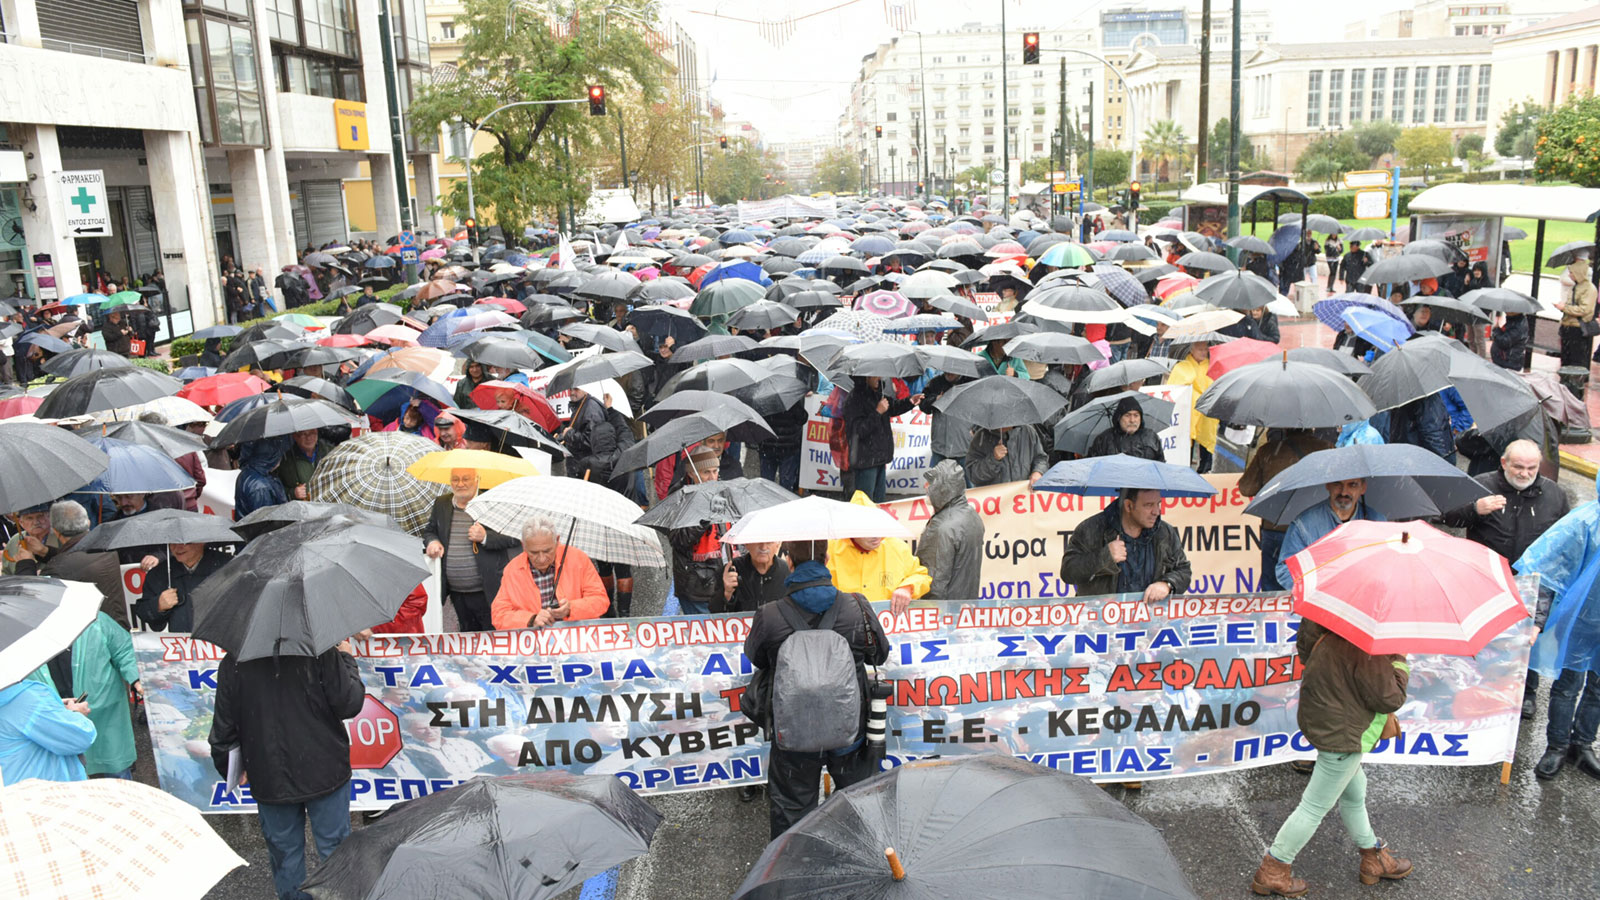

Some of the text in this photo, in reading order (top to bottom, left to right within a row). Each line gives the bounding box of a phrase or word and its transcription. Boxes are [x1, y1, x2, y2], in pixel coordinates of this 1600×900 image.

[61, 174, 101, 184] ΦΑΡΜΑΚΕΙΟ
[908, 434, 929, 448] ΤΩΝ
[890, 456, 926, 470] ΧΩΡΙΣ
[985, 533, 1047, 565] ώρα
[408, 623, 632, 656] ΣΥΝΤΑΞΙΟΥΧΙΚΕΣ
[637, 617, 754, 647] ΟΡΓΑΝΩ
[956, 603, 1085, 629] ΔΗΜΟΣΙΟΥ
[1103, 601, 1151, 624] ΟΤΑ
[375, 665, 445, 687] ΤΑ
[490, 659, 656, 684] ΧΕΡΙΑ
[426, 698, 507, 728] ΣΤΗ
[526, 692, 702, 725] ΔΙΑΛΥΣΗ
[886, 667, 1090, 706] ΝΩΝΙΚΗΣ
[1106, 654, 1305, 692] ΑΣΦΑΛΙΣ
[517, 740, 602, 767] ΑΠΟ
[621, 723, 760, 760] ΚΥΒΕΡ
[1048, 700, 1261, 738] ΚΕΦΑΛΑΙΟ
[615, 757, 761, 789] ΩΡΕΑΝ
